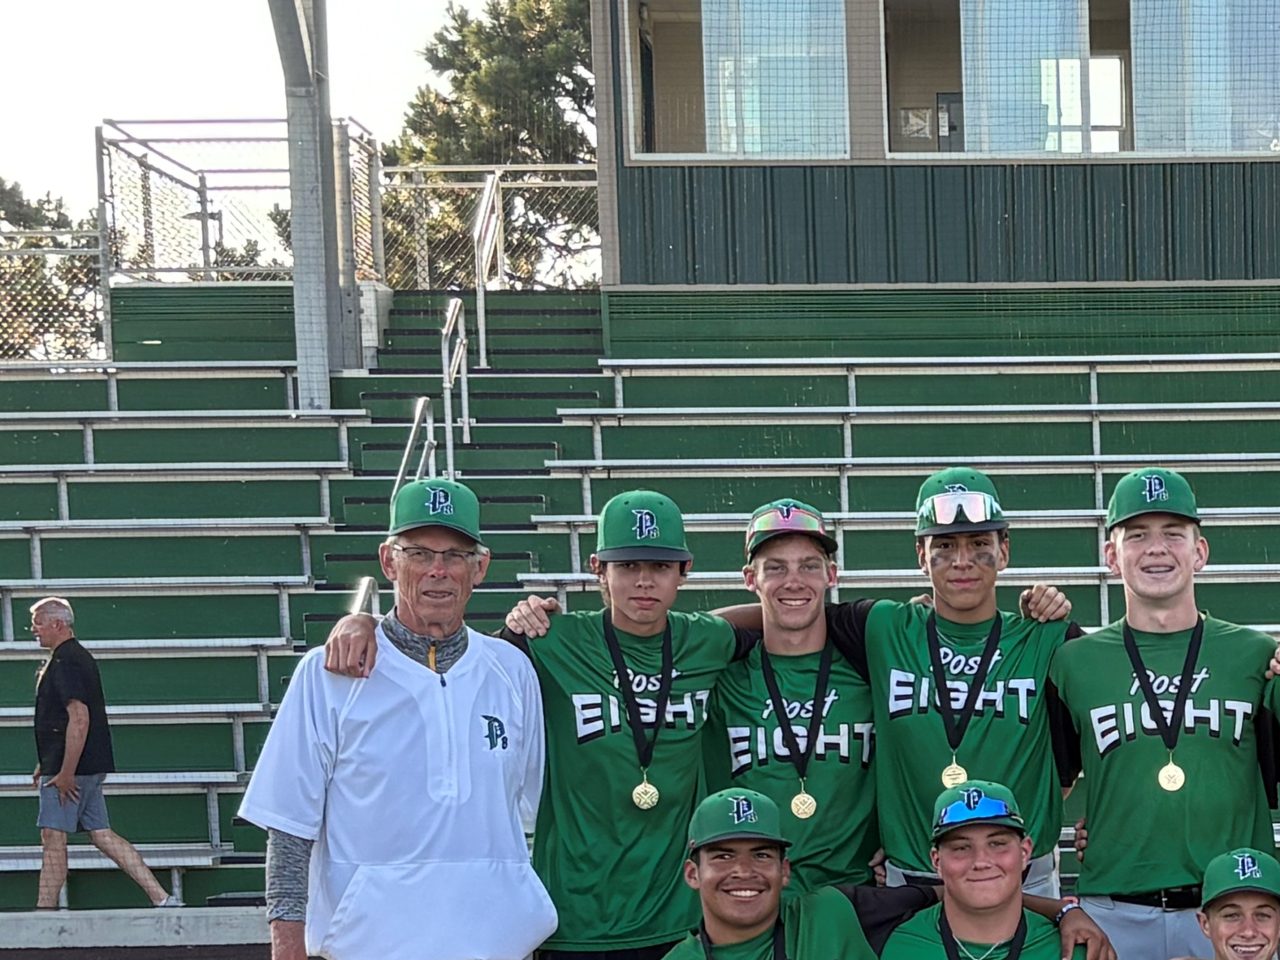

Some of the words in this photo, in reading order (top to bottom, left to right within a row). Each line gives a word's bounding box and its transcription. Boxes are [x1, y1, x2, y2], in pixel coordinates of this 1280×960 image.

[888, 668, 1037, 725] EIGHT
[727, 722, 876, 779] EIGHT
[1090, 699, 1252, 760] EIGHT
